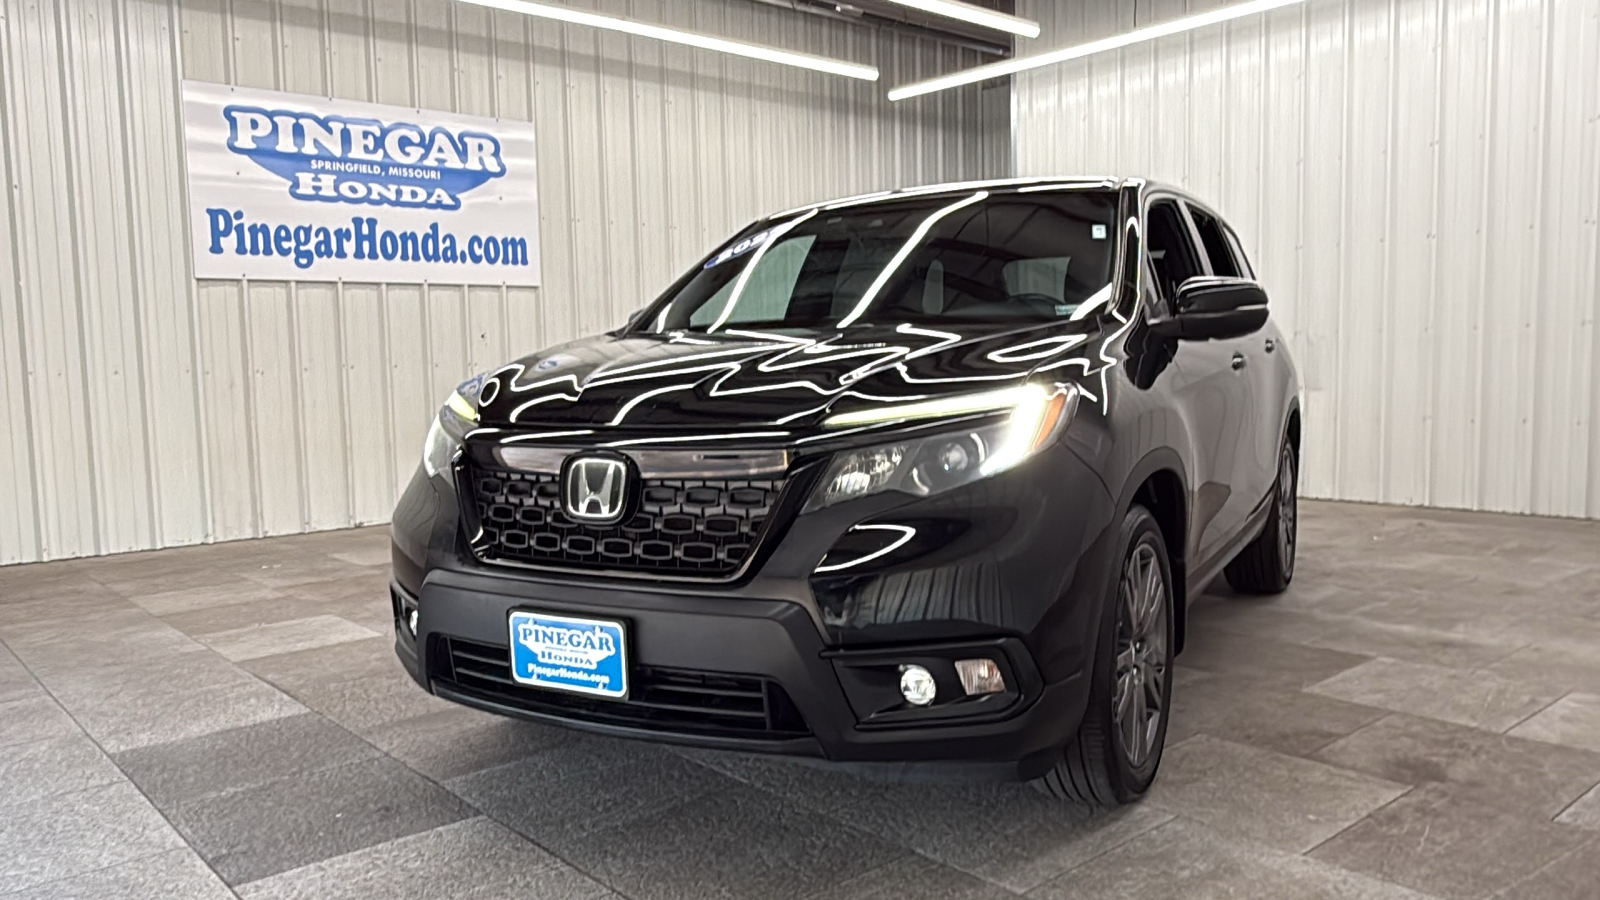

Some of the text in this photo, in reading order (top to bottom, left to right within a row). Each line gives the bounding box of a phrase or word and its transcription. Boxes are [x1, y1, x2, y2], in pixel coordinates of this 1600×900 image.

[229, 110, 501, 172] PINEGAR
[310, 159, 441, 180] SPRINGFIELD, MISSOURI
[206, 208, 529, 268] PinegarHonda.com
[522, 627, 612, 652] PINEGAR
